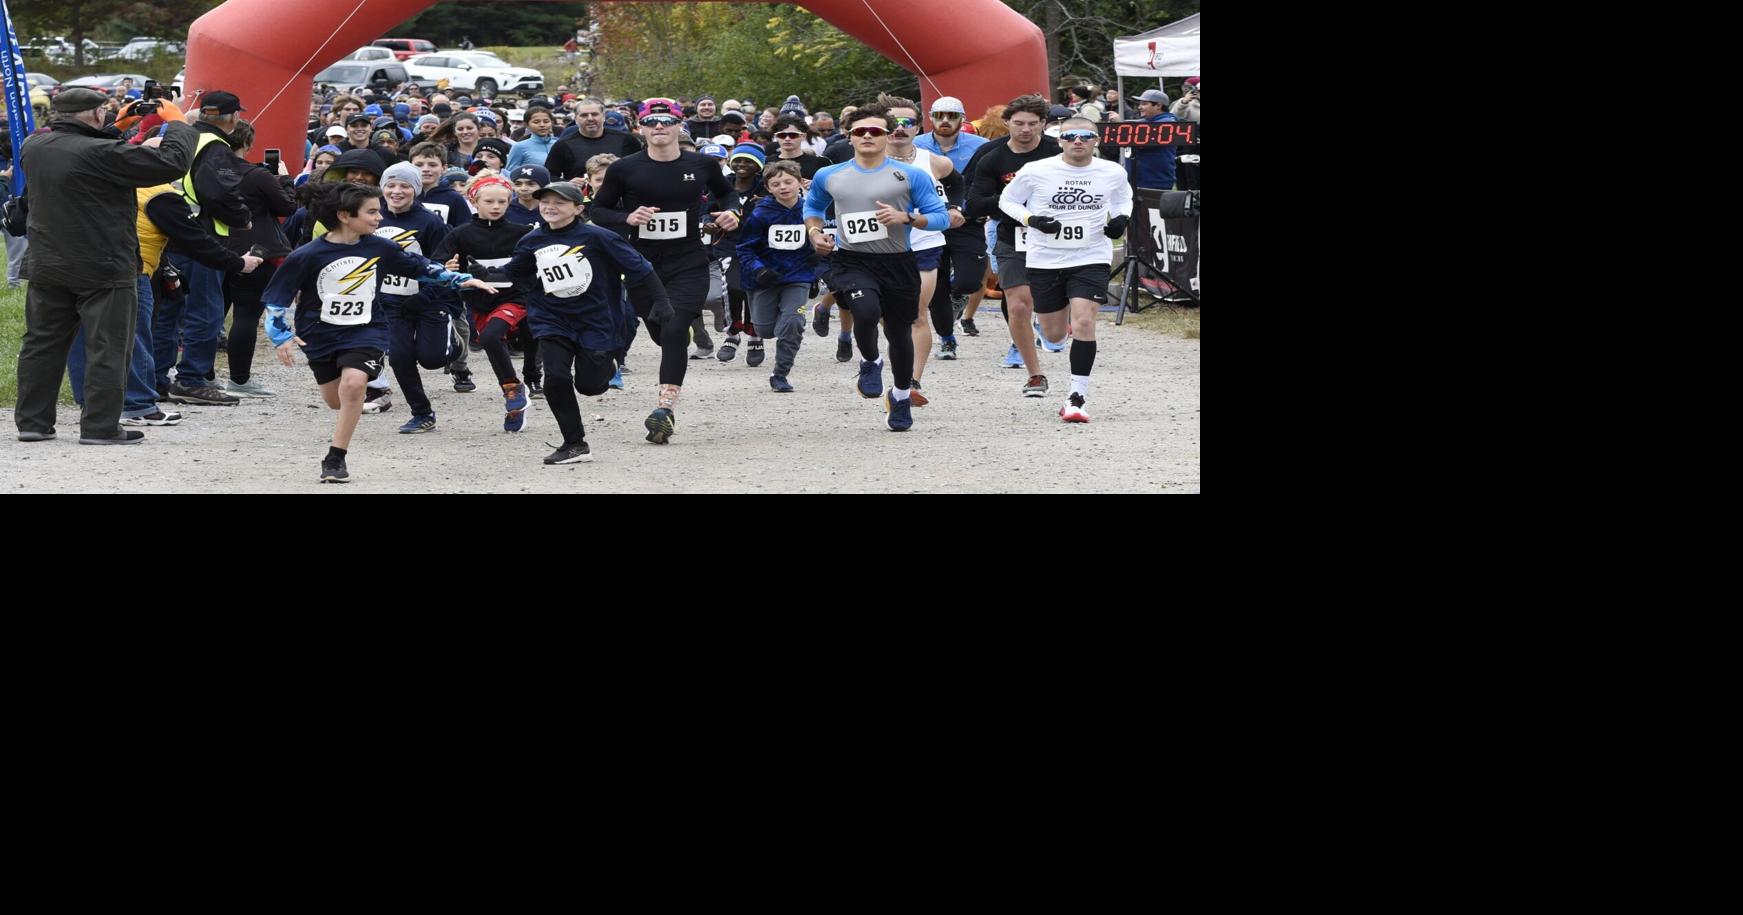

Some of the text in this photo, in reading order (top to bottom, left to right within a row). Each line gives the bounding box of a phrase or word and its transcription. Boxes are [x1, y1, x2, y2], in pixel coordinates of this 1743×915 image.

[646, 218, 679, 232] 615
[847, 217, 879, 234] 926
[774, 230, 801, 242] 520
[325, 259, 354, 273] Christi
[543, 263, 574, 283] 501
[383, 273, 410, 288] 537
[329, 300, 365, 316] 523
